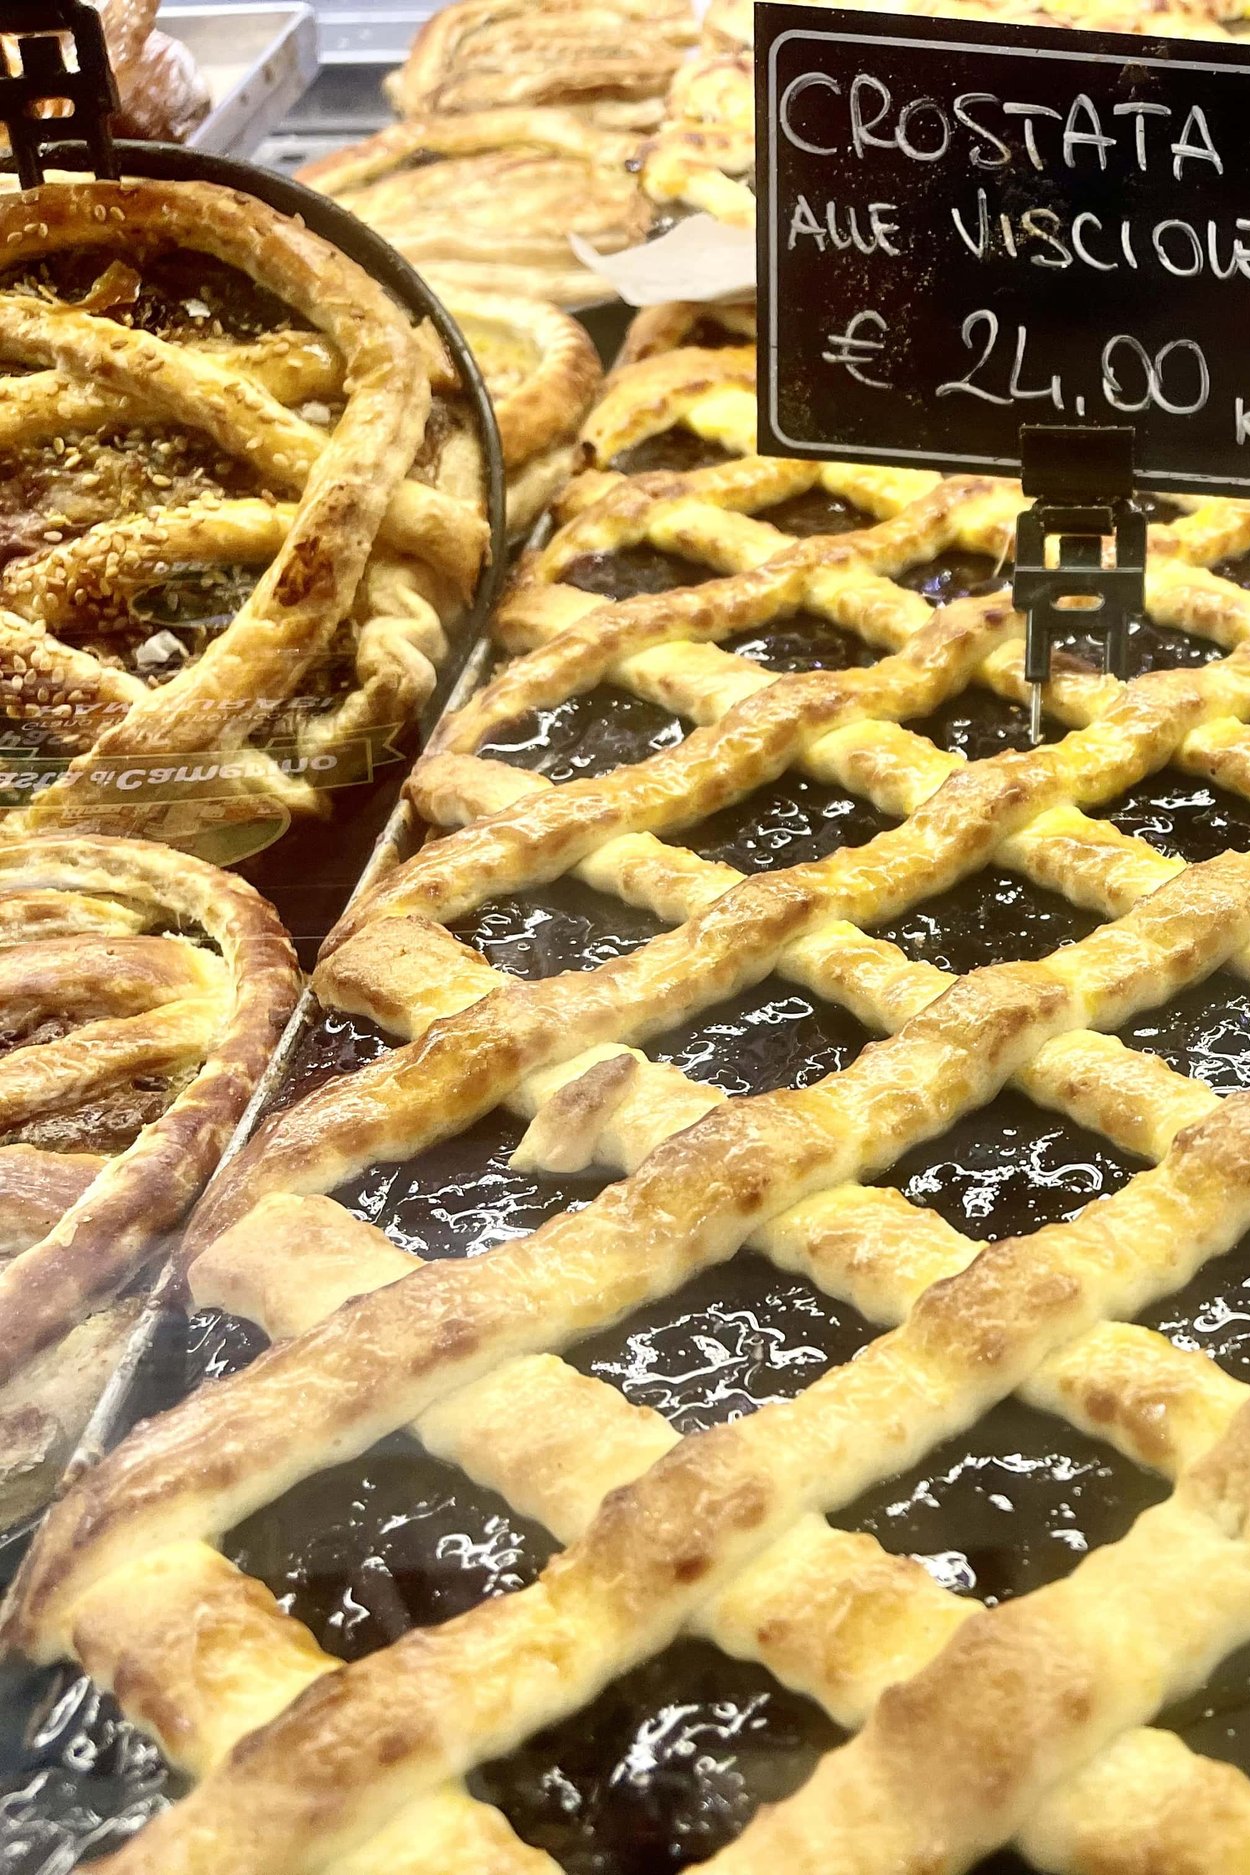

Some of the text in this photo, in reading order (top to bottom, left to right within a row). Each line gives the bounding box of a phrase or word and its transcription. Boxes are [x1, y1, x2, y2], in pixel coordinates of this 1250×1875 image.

[779, 72, 1224, 181] CROSTATA
[787, 194, 901, 256] ALLE
[822, 309, 894, 390] €
